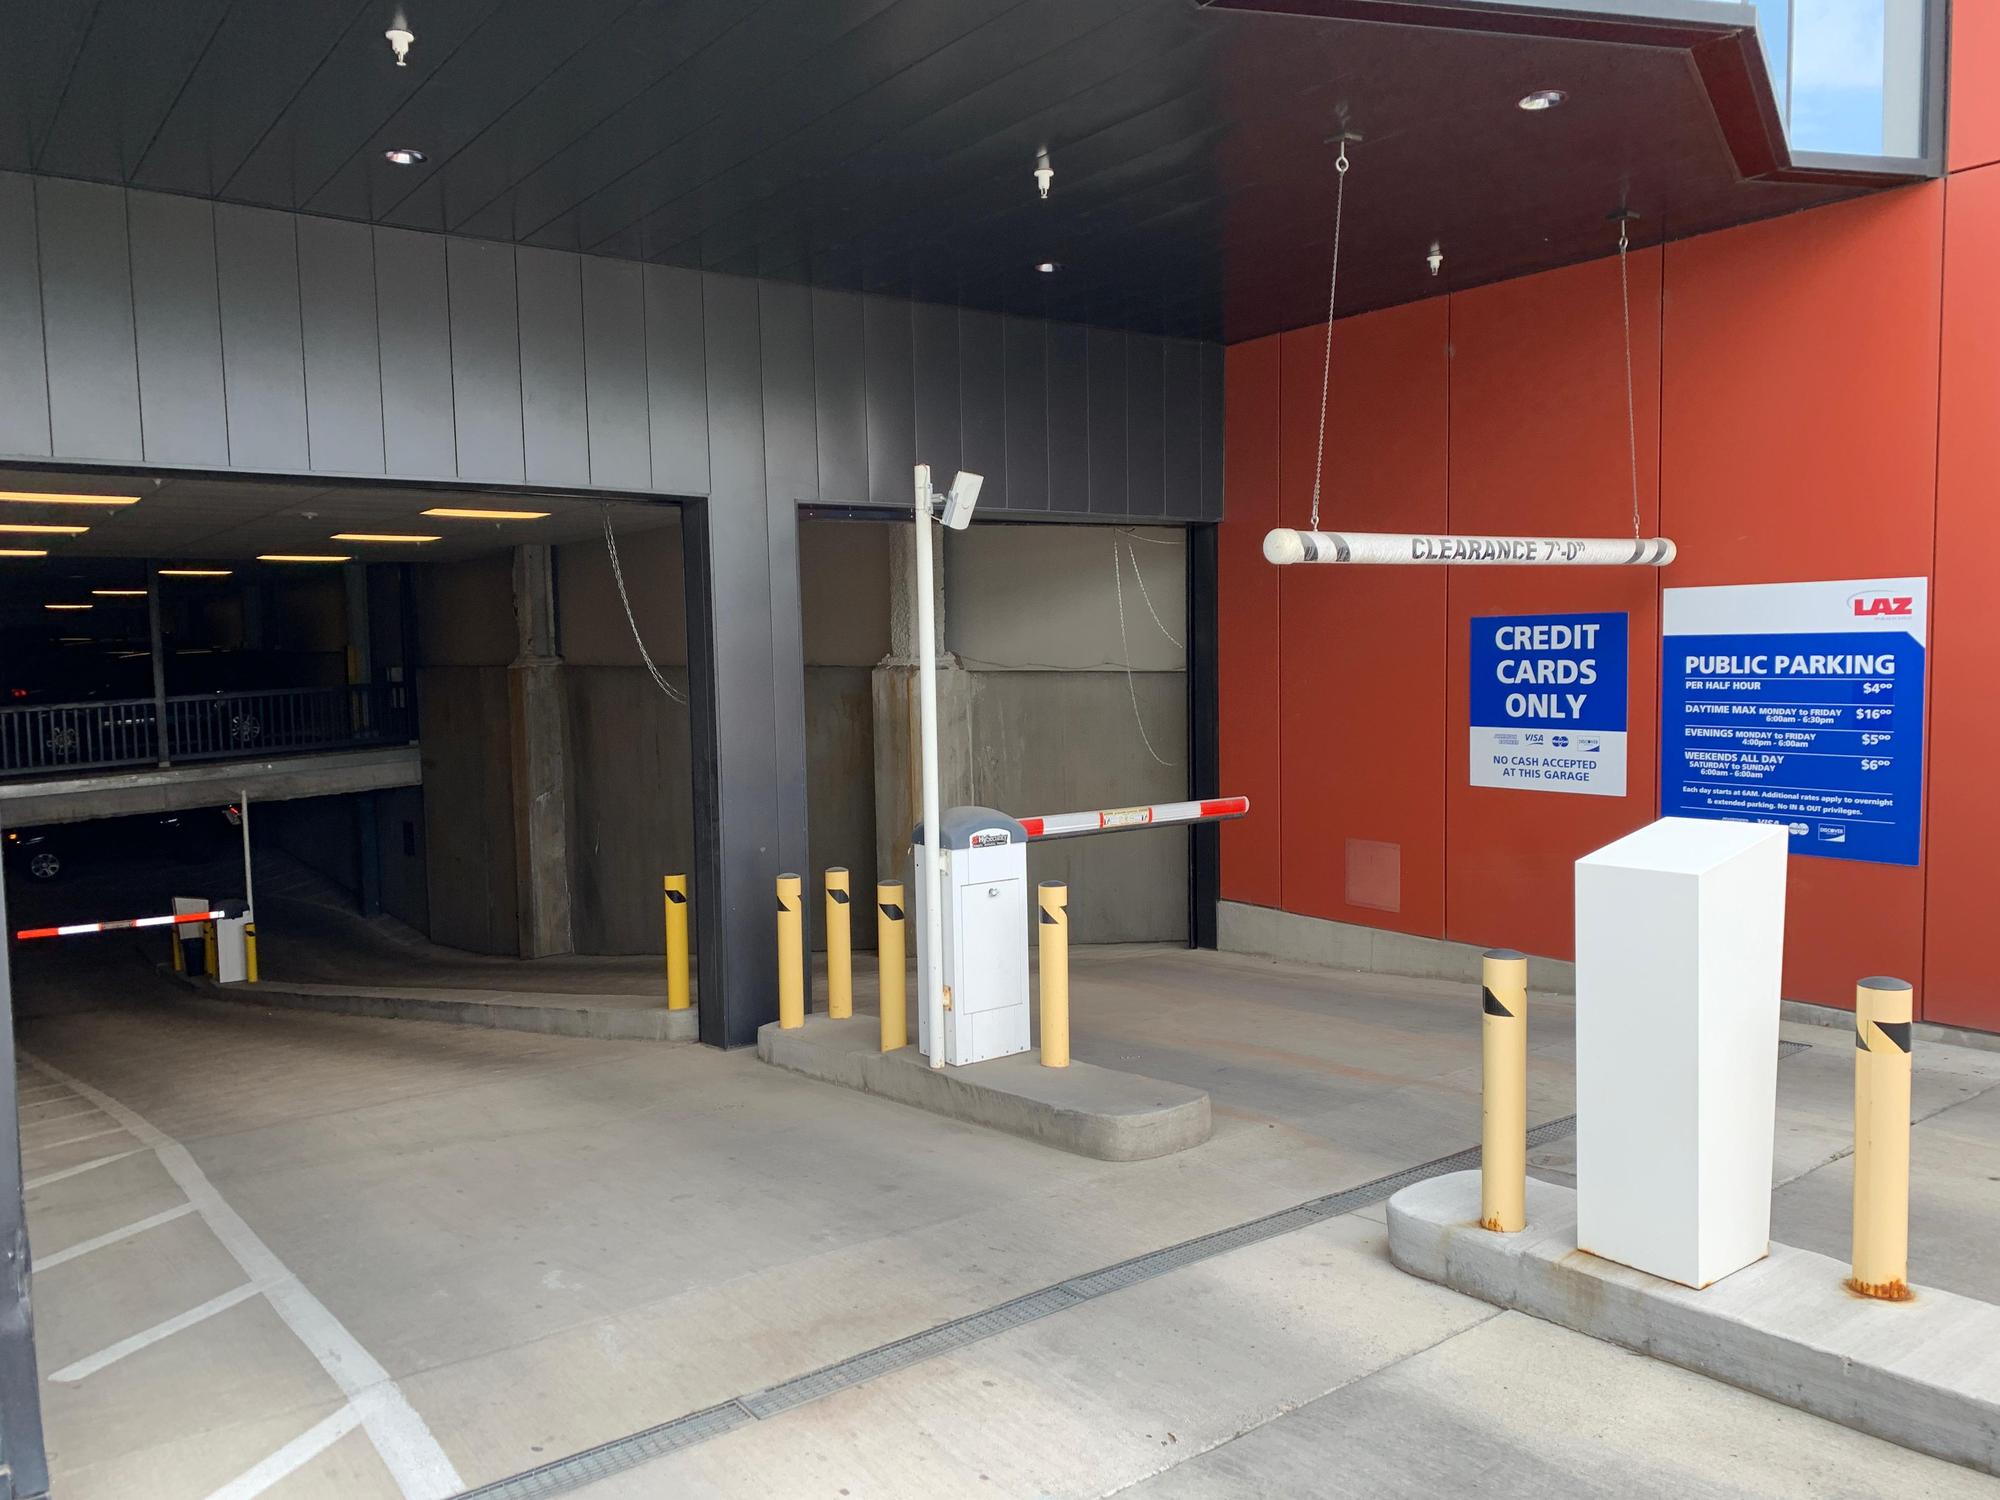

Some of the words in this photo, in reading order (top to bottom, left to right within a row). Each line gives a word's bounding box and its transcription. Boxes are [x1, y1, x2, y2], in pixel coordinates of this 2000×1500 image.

[1412, 537, 1537, 561] CLEARANCE
[1855, 597, 1912, 616] LAZ
[1495, 624, 1600, 651] CREDIT
[1685, 655, 1768, 674] PUBLIC
[1775, 654, 1895, 675] PARKING
[1496, 659, 1597, 684] CARDS
[1685, 681, 1704, 690] PER
[1706, 681, 1730, 690] HALF
[1732, 682, 1761, 690] HOUR
[1505, 693, 1587, 719] ONLY
[1685, 704, 1730, 714] DAYTIME
[1732, 705, 1756, 714] MAX
[1759, 707, 1797, 715] MONDAY
[1810, 708, 1842, 716] FRIDAY
[1802, 716, 1834, 725] 6:30pm
[1525, 734, 1544, 742] VISA
[1685, 728, 1733, 738] EVENINGS
[1735, 731, 1772, 739] MONDAY
[1785, 732, 1816, 741] FRIDAY
[1742, 738, 1772, 747] 4:00pm
[1778, 740, 1808, 748] 6:00am
[1493, 756, 1508, 764] NO
[1511, 756, 1539, 766] CASH
[1542, 758, 1597, 770] ACCEPTED
[1685, 751, 1737, 762] WEEKENDS
[1741, 754, 1759, 763] ALL
[1761, 755, 1784, 764] DAY
[1689, 761, 1730, 769] SATURDAY
[1742, 764, 1776, 772] SUNDAY
[1503, 768, 1516, 776] AT
[1518, 769, 1540, 778] THIS
[1544, 770, 1590, 781] GARAGE
[1700, 768, 1728, 777] 6:00am
[1734, 770, 1763, 779] 6:00am
[1699, 787, 1712, 796] day
[1742, 790, 1760, 798] 6AM.
[1761, 791, 1800, 801] Additional
[1821, 795, 1842, 804] apply
[1854, 798, 1893, 806] overnight
[1714, 799, 1746, 807] extended
[1747, 801, 1776, 810] parking.
[1823, 806, 1863, 816] privileges.
